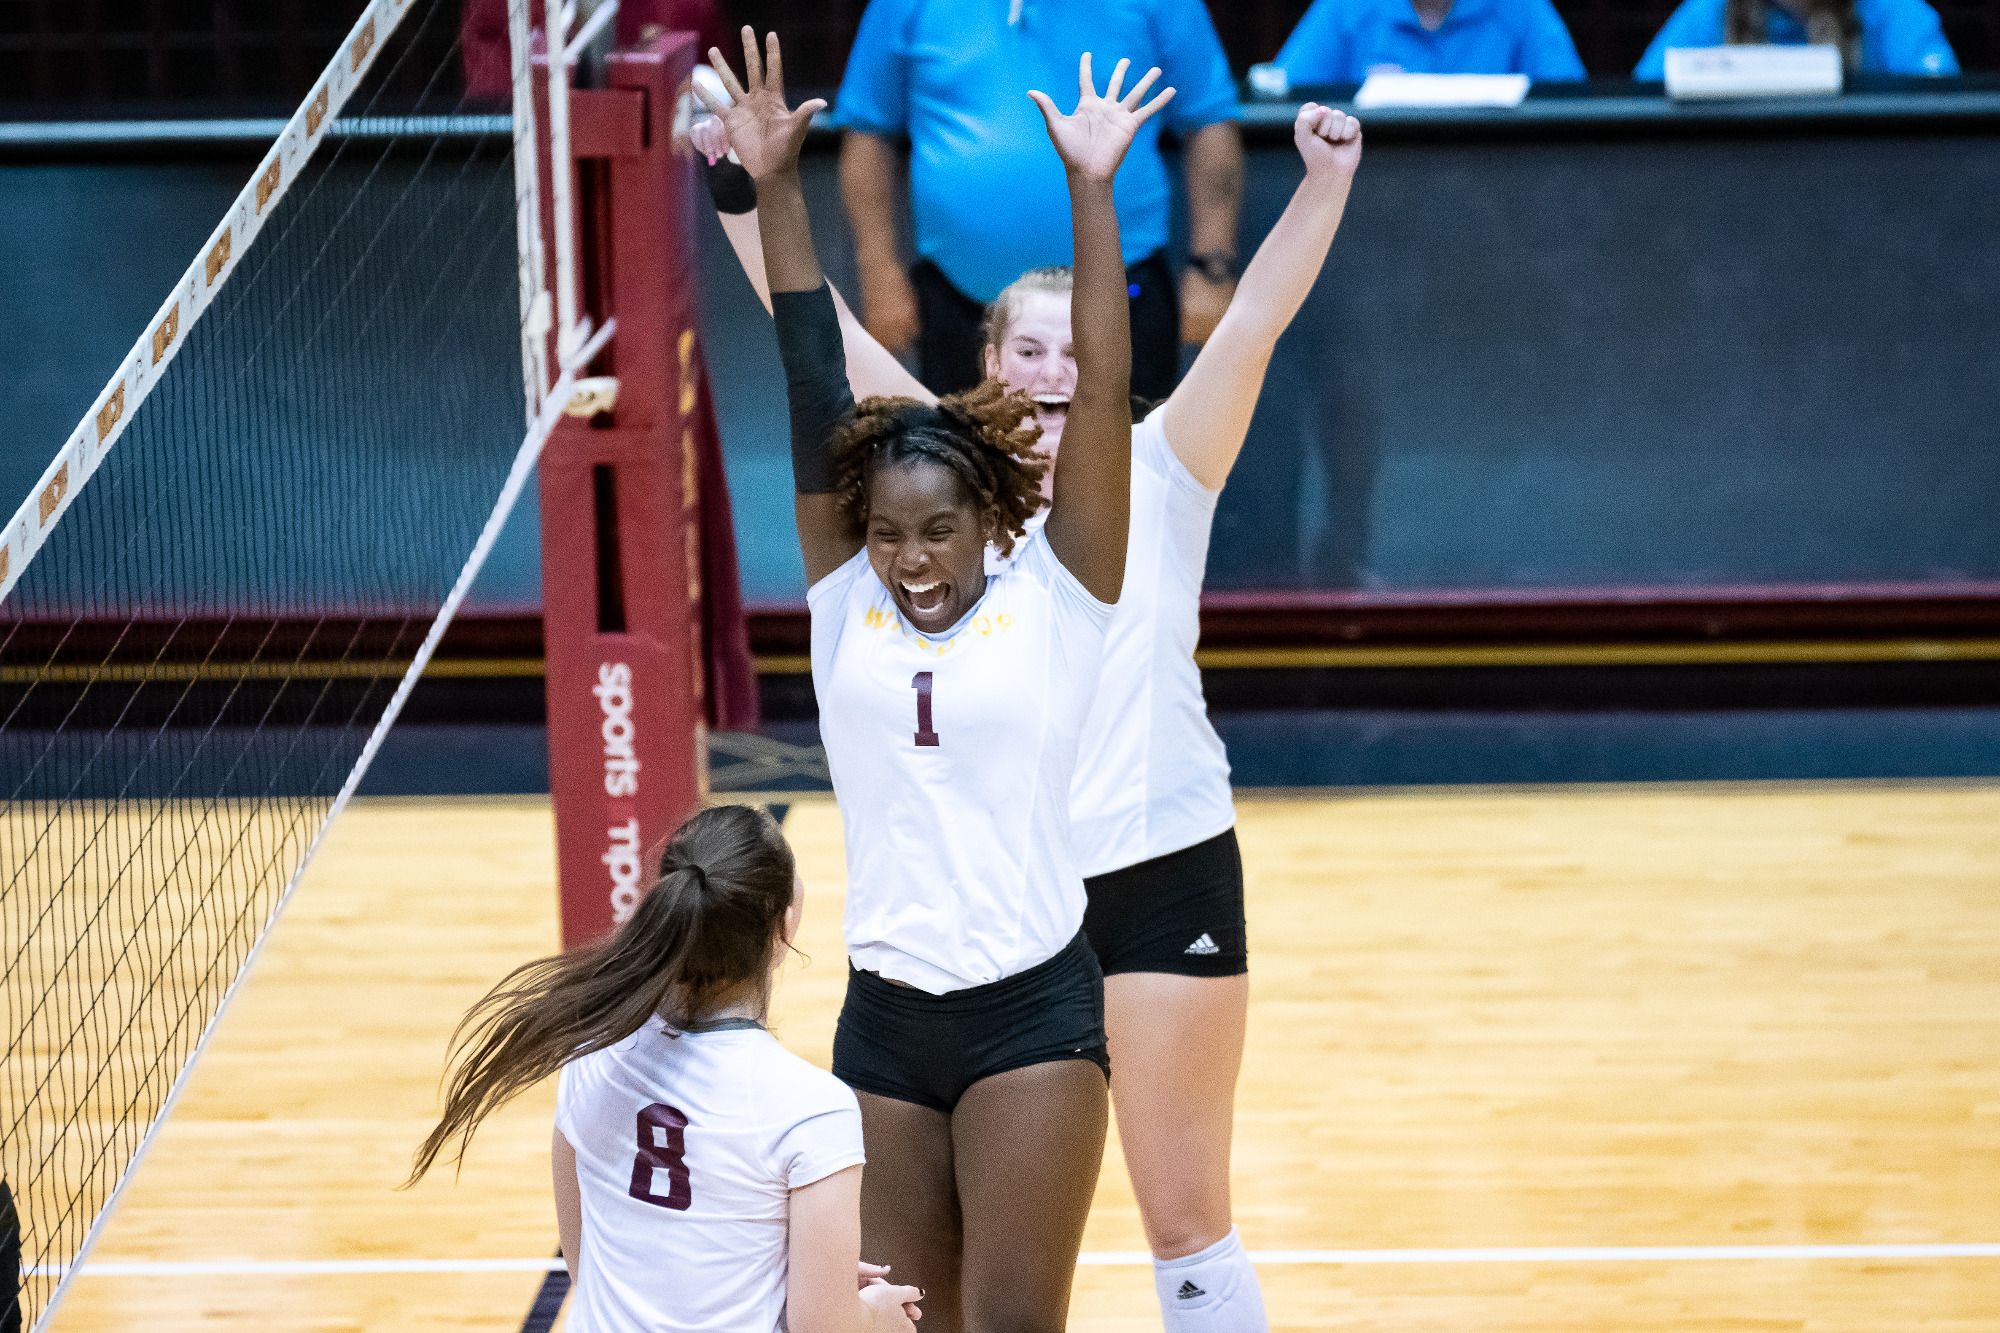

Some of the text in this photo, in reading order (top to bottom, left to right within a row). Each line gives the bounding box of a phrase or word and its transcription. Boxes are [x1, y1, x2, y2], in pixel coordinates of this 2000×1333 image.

[592, 661, 642, 798] sports
[911, 671, 940, 747] 1
[629, 1102, 691, 1211] 8
